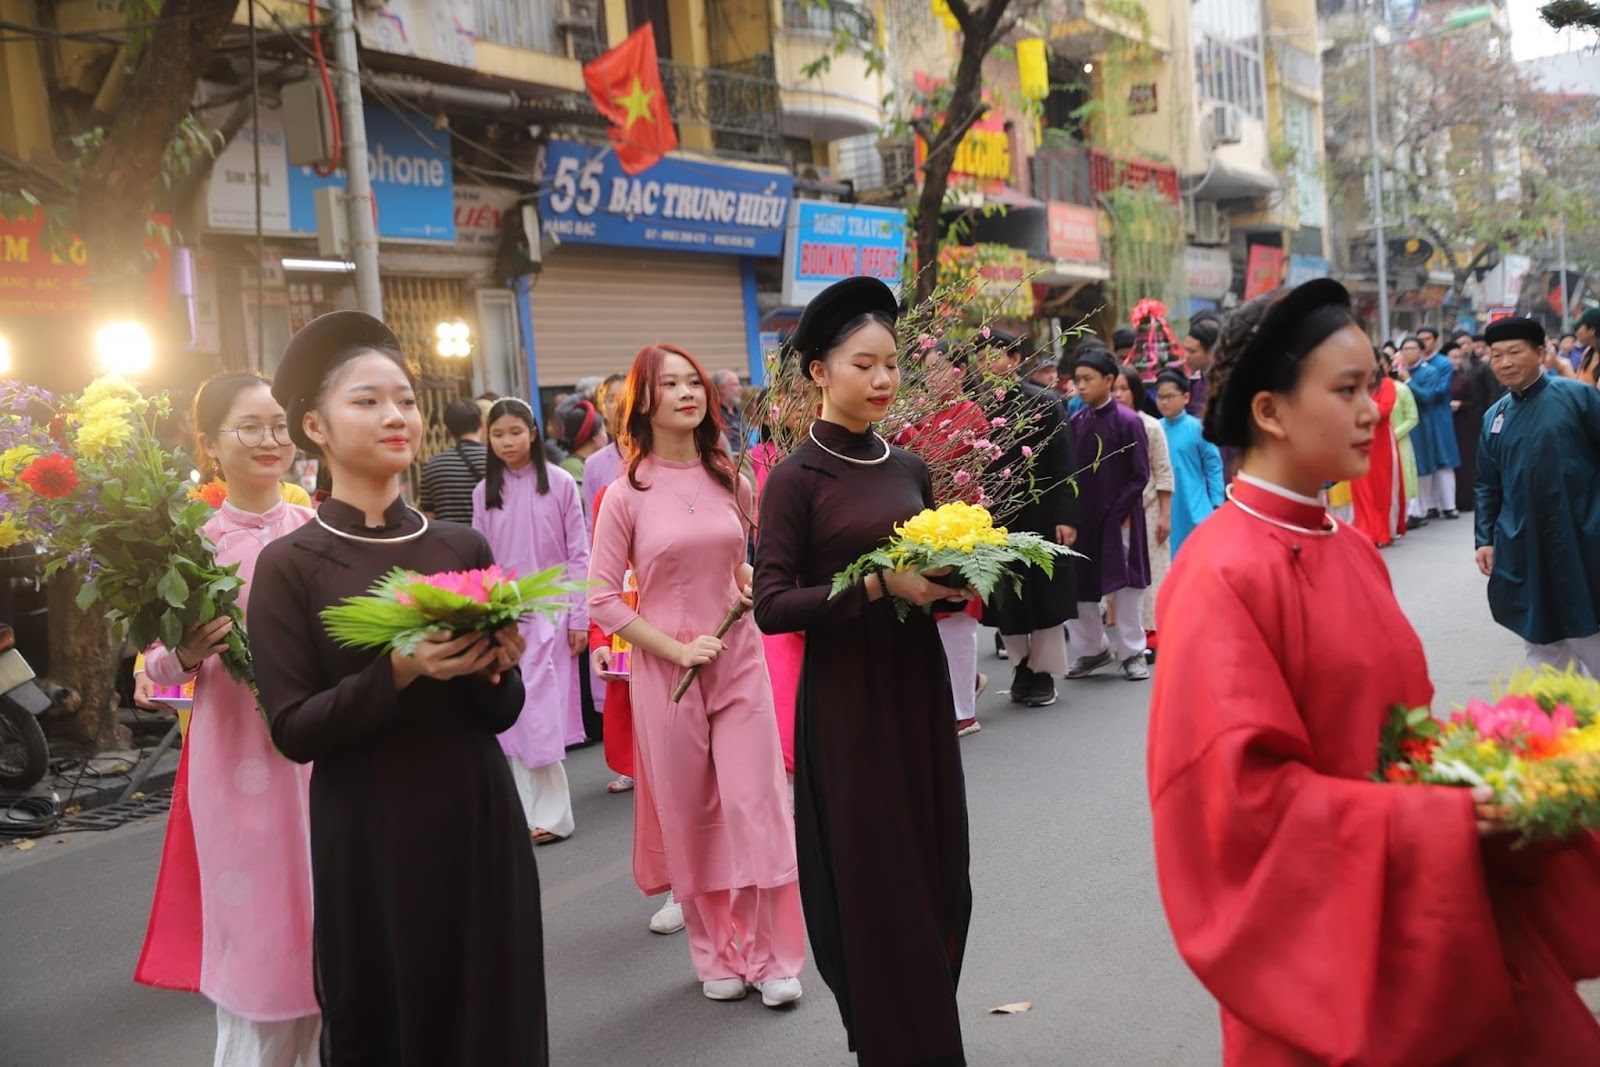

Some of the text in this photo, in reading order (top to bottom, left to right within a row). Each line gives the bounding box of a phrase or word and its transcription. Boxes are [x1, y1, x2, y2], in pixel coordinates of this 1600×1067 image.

[549, 156, 605, 216] 55
[608, 177, 787, 228] BẠC TRUNG HIẾU
[801, 242, 899, 279] BOOKING OFFICE
